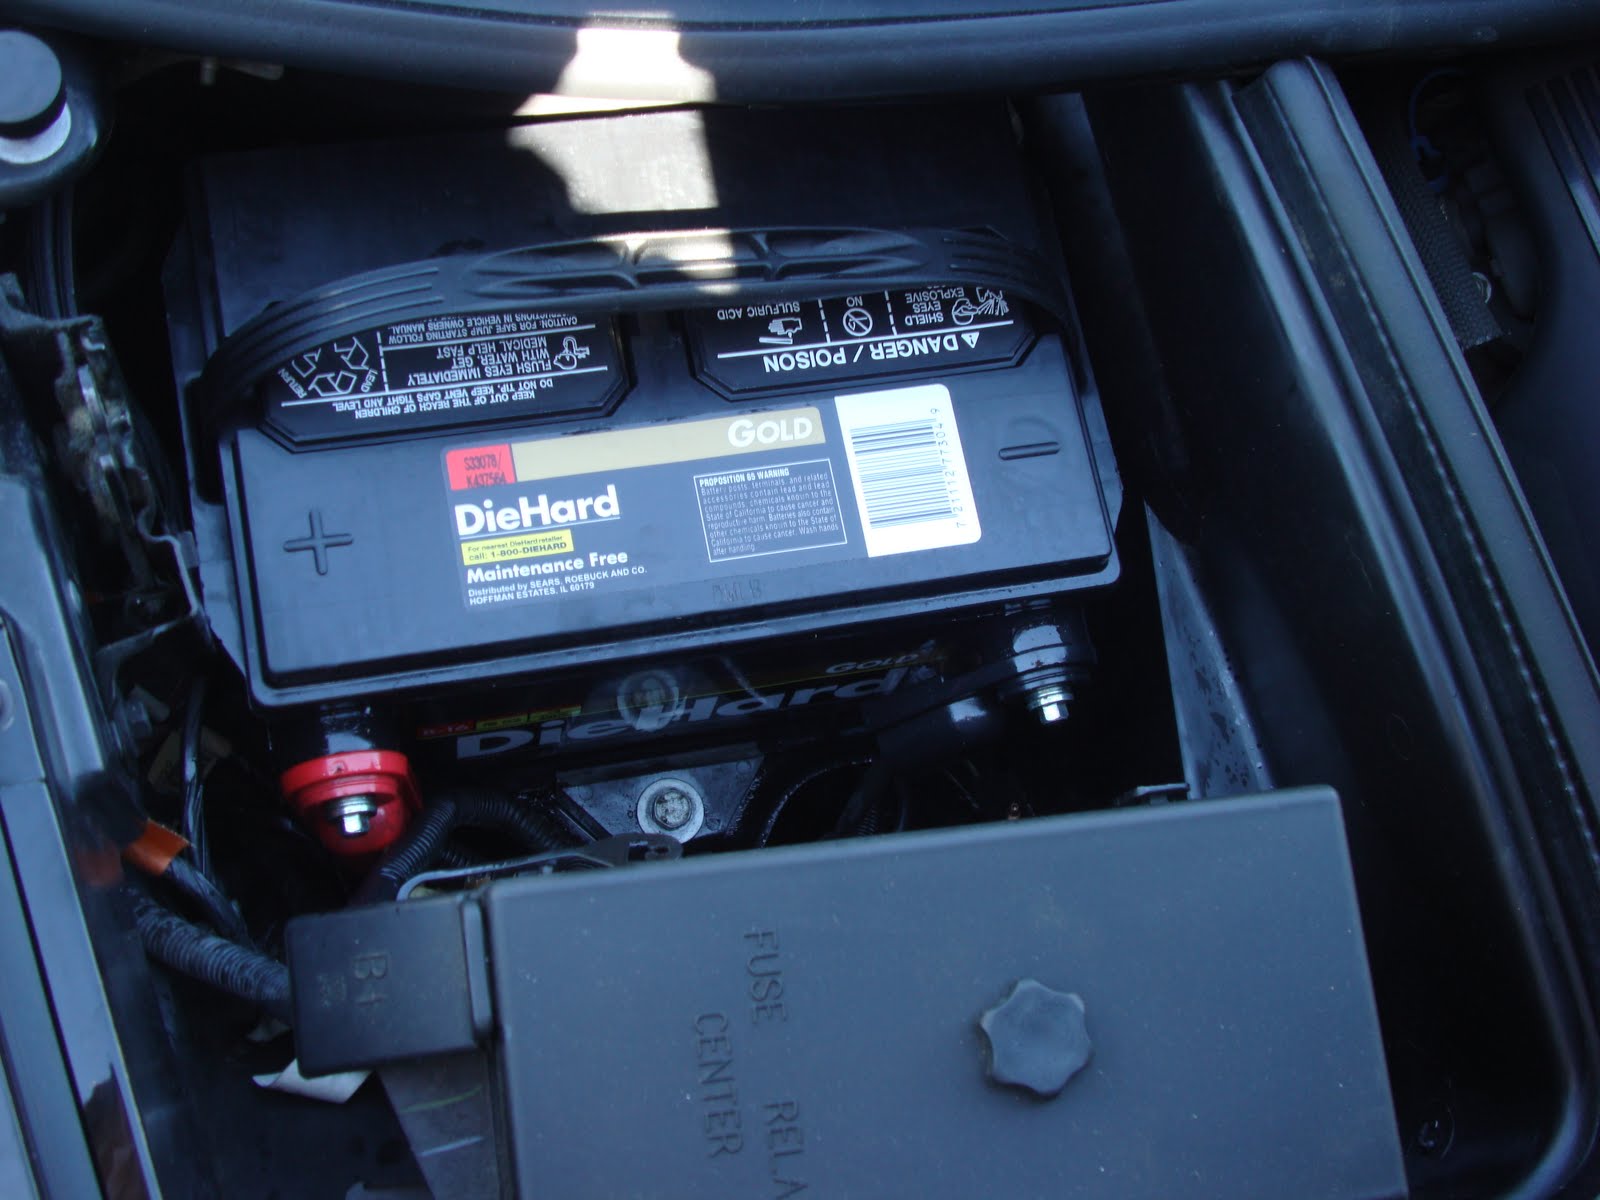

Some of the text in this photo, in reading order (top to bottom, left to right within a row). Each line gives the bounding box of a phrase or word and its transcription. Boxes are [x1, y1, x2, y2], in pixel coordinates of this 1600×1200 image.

[846, 296, 863, 307] NO
[905, 287, 965, 303] EXPLOSIVE
[717, 301, 800, 320] SULFURIC ACID
[912, 301, 941, 313] EYES
[428, 318, 464, 330] OWNERS
[467, 315, 500, 325] VEHICLE
[504, 314, 512, 323] IN
[905, 312, 944, 326] SHIELD
[471, 325, 493, 335] JUMP
[496, 323, 517, 333] SAFE
[520, 322, 537, 331] FOR
[389, 332, 423, 344] FOLLOW
[426, 327, 467, 341] STARTING
[436, 336, 547, 359] MEDICAL HELP FAST
[870, 334, 959, 360] DANGER
[522, 348, 549, 361] WITH
[763, 347, 846, 373] POISON
[451, 357, 473, 369] GET
[408, 360, 551, 386] FLUSH EYES IMMEDIATELY
[360, 368, 378, 393] LEAD
[519, 381, 536, 391] NOT
[540, 379, 553, 388] DO
[417, 391, 441, 402] CAPS
[444, 388, 467, 399] VENT
[471, 385, 494, 396] KEEP
[355, 391, 535, 419] KEEP OUT OF THE REACH OF CHILDREN
[364, 397, 383, 407] AND
[387, 394, 413, 405] TIGHT
[728, 417, 812, 447] GOLD
[700, 467, 789, 487] PROPOSITION 65 WARNING
[454, 484, 620, 536] DieHard
[481, 541, 508, 551] nearest
[510, 538, 537, 547] DieHard
[538, 536, 563, 544] retailer
[491, 542, 567, 558] 1-800-DIEHARD
[467, 552, 628, 584] Maintenance Free
[468, 584, 515, 597] Distributed
[518, 582, 528, 592] by
[565, 571, 608, 584] ROEBUCK
[610, 567, 629, 577] AND
[632, 566, 647, 575] CO.
[470, 593, 514, 605] HOFFMAN
[570, 582, 594, 592] 60179
[743, 928, 789, 1026] FUSE
[696, 1011, 745, 1159] CENTER
